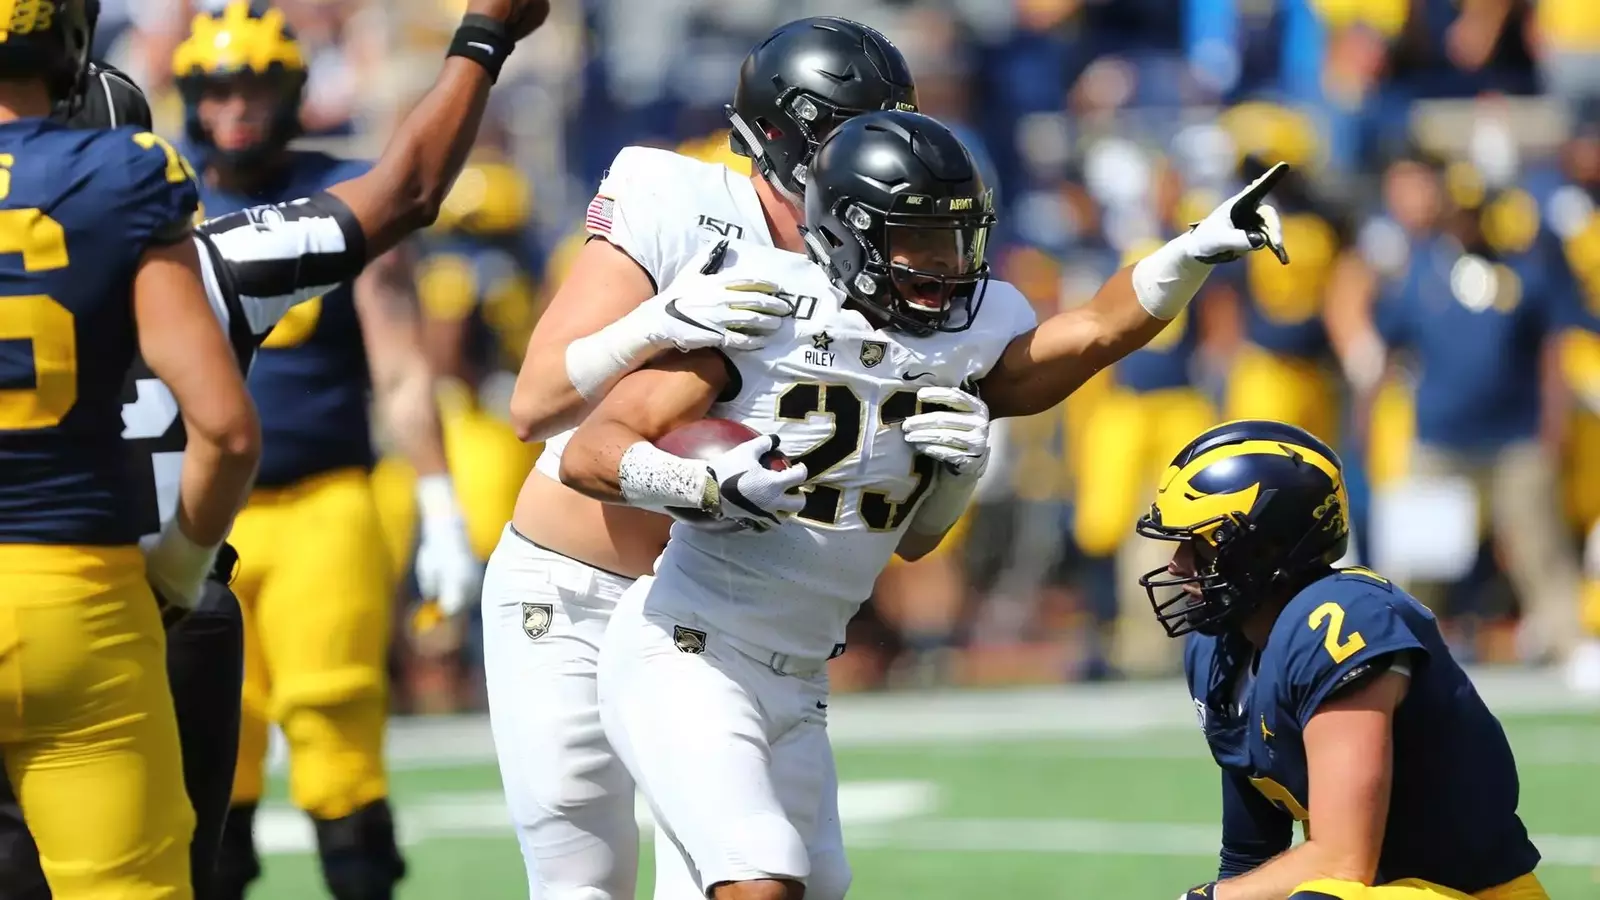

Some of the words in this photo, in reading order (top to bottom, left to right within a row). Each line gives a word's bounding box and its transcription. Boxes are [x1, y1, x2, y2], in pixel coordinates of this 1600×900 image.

[949, 197, 973, 211] ARMY
[804, 350, 836, 367] RILEY
[1307, 601, 1367, 664] 2
